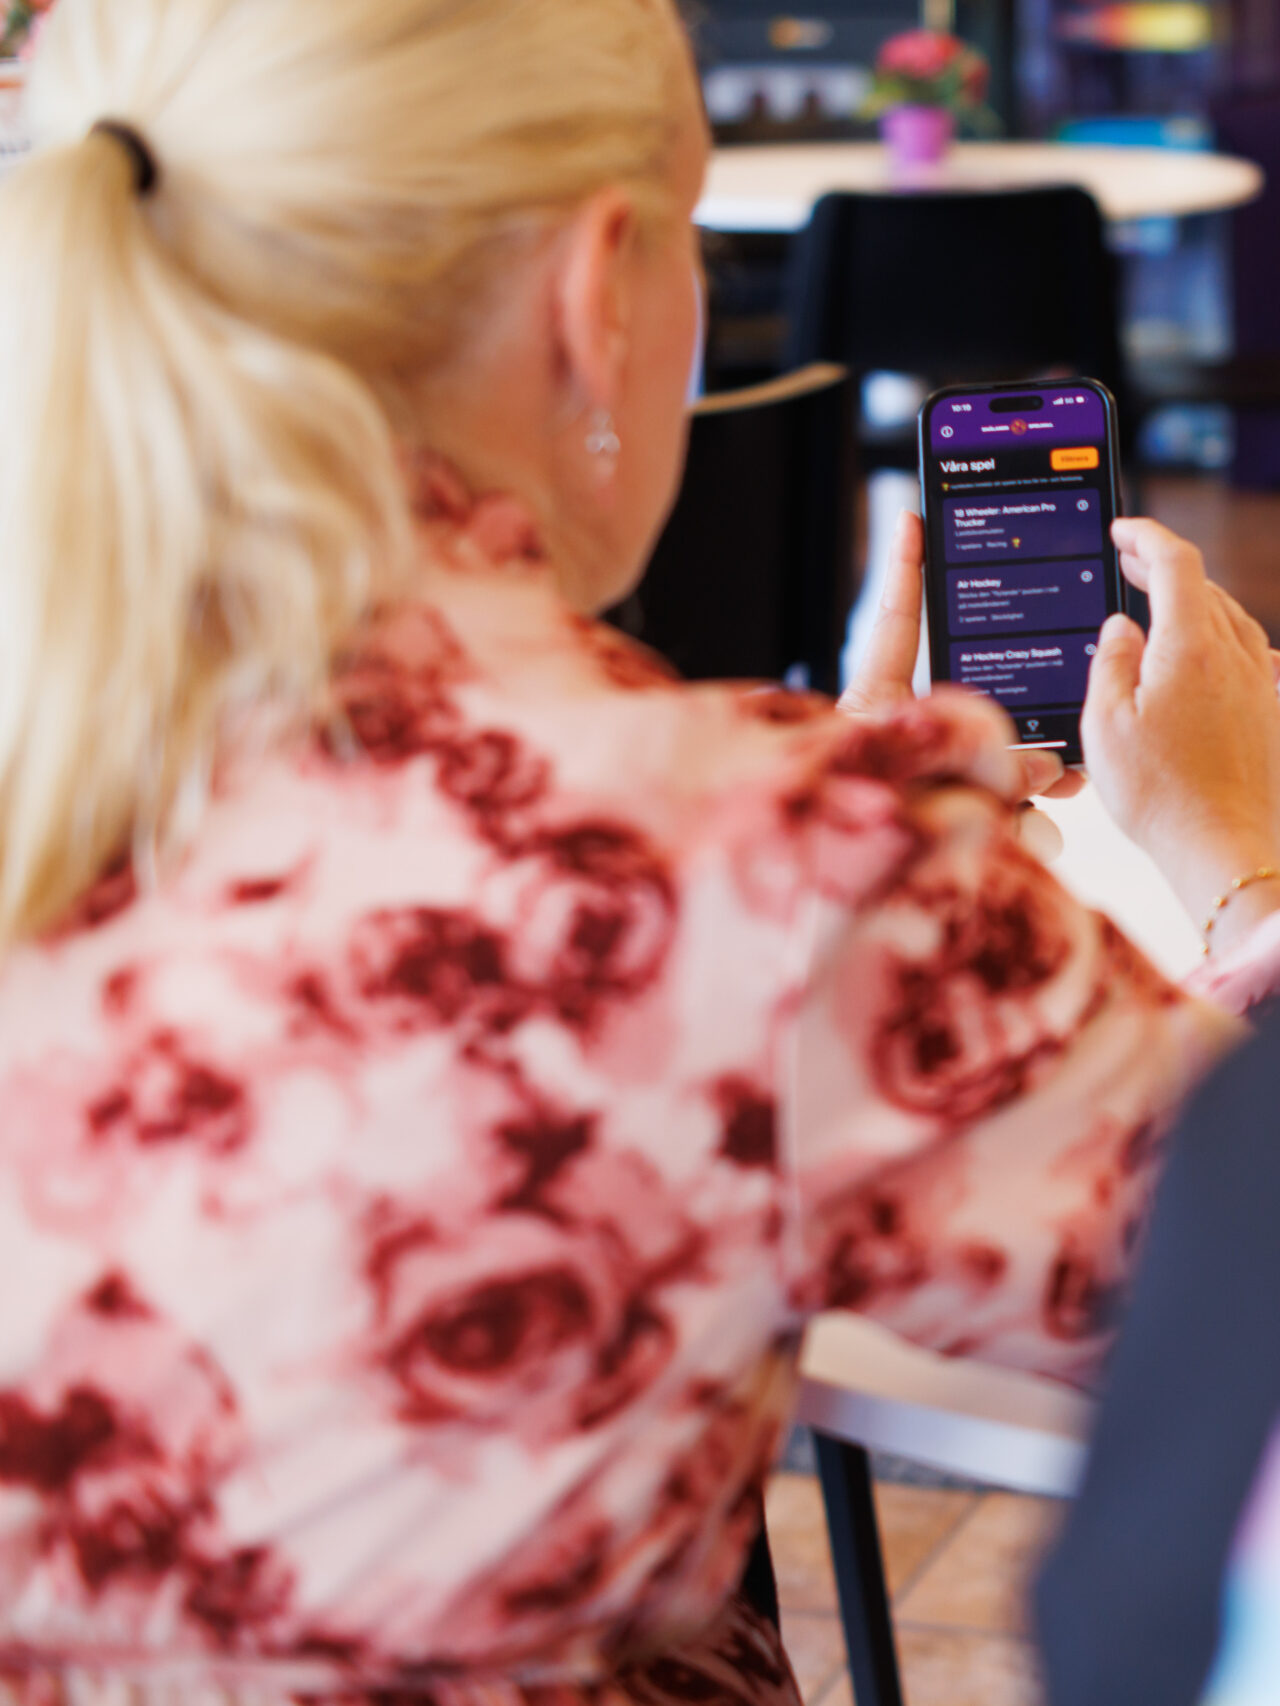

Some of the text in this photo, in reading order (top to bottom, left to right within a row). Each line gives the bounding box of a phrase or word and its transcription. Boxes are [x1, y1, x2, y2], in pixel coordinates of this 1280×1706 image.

[940, 458, 996, 472] Våra spel
[1002, 504, 1040, 515] American
[1040, 503, 1056, 512] Pro
[954, 518, 986, 528] Trucker
[957, 579, 1001, 589] Air Hockey
[960, 648, 1062, 662] Air Hockey Crazy Squash
